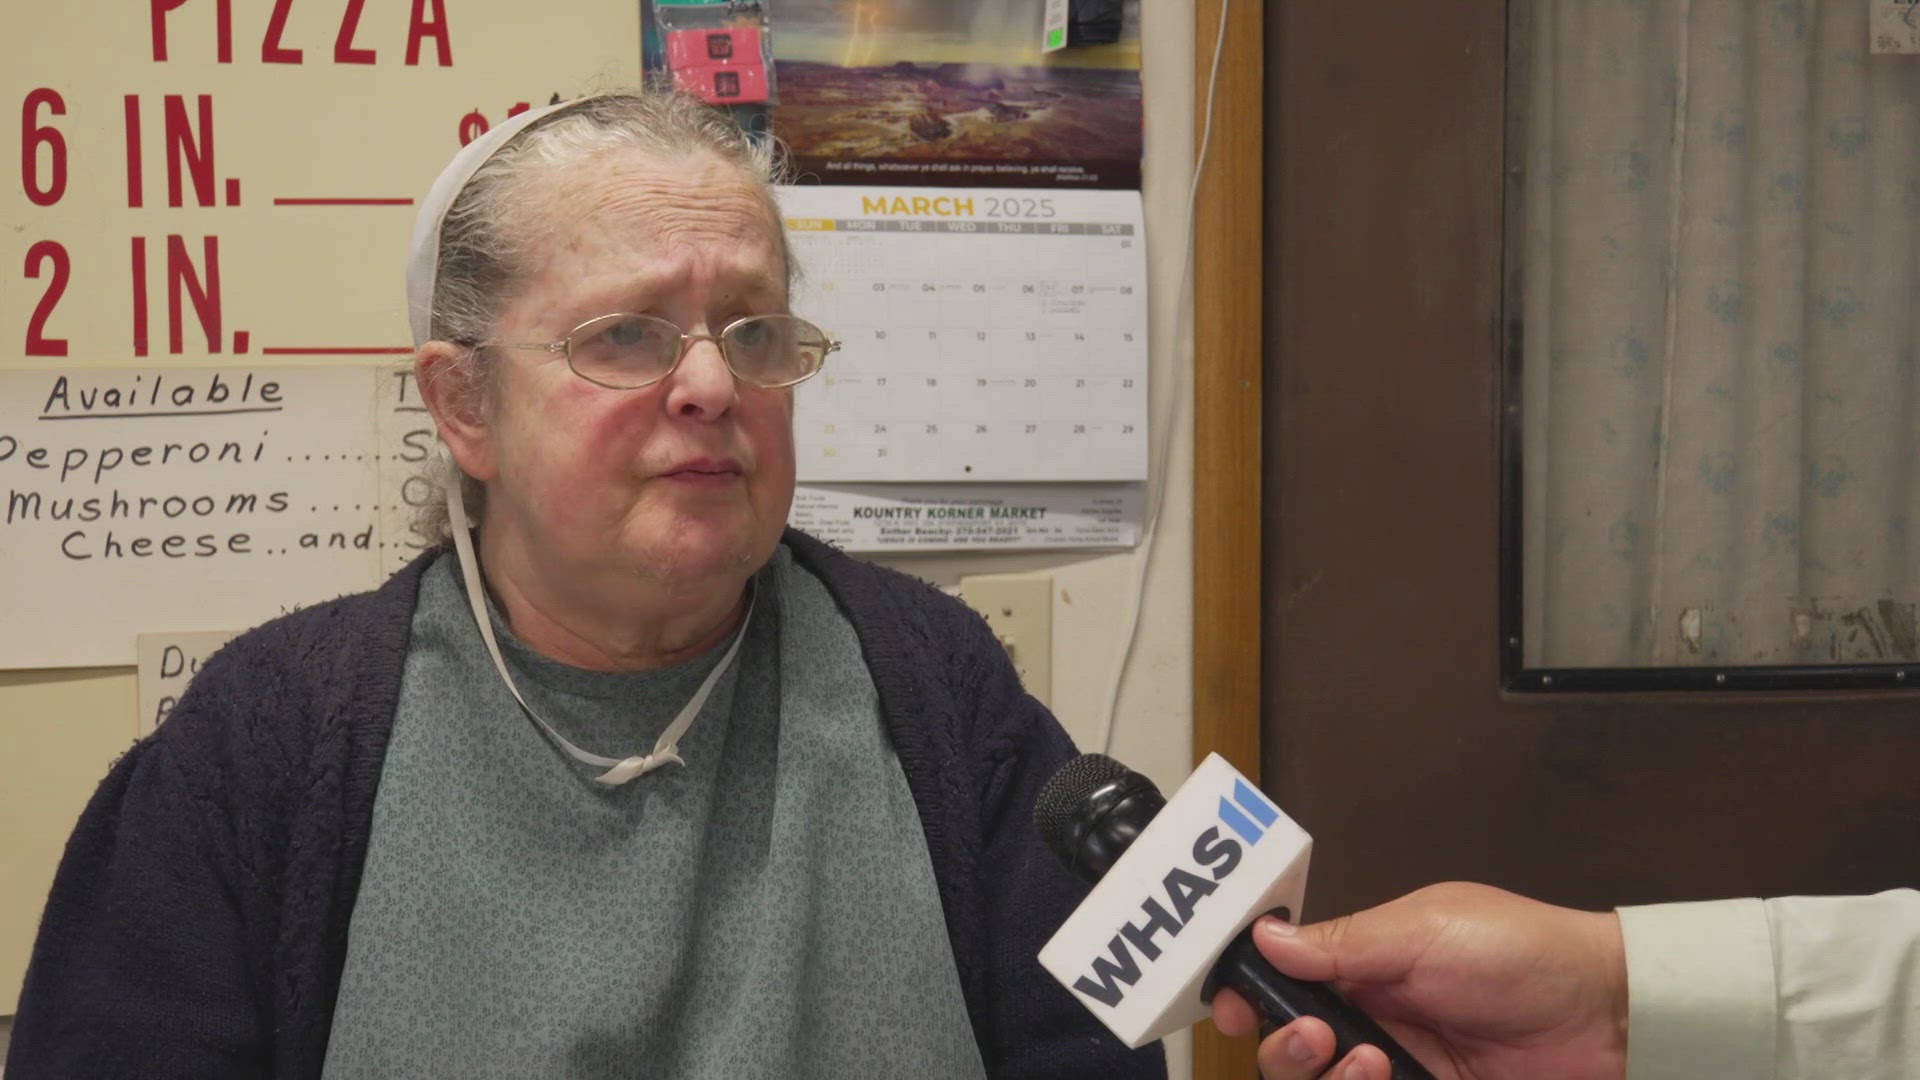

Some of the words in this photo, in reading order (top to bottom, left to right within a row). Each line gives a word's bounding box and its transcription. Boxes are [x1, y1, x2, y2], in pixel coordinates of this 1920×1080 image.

[21, 87, 67, 206] 6
[124, 94, 241, 208] IN.
[826, 161, 842, 170] And
[862, 196, 975, 217] MARCH
[985, 197, 1057, 218] 2025
[798, 221, 822, 229] SUN
[848, 222, 875, 231] MON
[900, 222, 922, 231] TUE
[948, 223, 977, 232] WED
[998, 223, 1021, 232] THU
[1051, 224, 1069, 233] FRI
[1102, 225, 1121, 234] SAT
[872, 282, 886, 292] 03
[921, 283, 936, 292] 04
[972, 283, 986, 294] 05
[1022, 284, 1035, 294] 06
[1071, 285, 1085, 294] 07
[1119, 285, 1133, 296] 08
[24, 240, 71, 357] 2
[131, 235, 250, 357] IN.
[928, 331, 937, 340] 11
[976, 331, 987, 341] 12
[1074, 333, 1085, 342] 14
[1123, 333, 1134, 343] 15
[876, 377, 887, 386] 17
[926, 378, 937, 387] 18
[976, 378, 988, 387] 19
[1024, 378, 1037, 388] 20
[1075, 378, 1086, 388] 21
[1122, 378, 1134, 389] 22
[43, 373, 284, 413] Available
[874, 423, 887, 434] 24
[926, 423, 938, 434] 25
[975, 424, 988, 434] 26
[1024, 424, 1037, 434] 27
[1073, 424, 1086, 434] 28
[1121, 424, 1134, 434] 29
[7, 489, 290, 524] Mushrooms
[853, 506, 922, 519] KOUNTRY
[927, 507, 986, 519] KORNER
[990, 507, 1048, 519] MARKET
